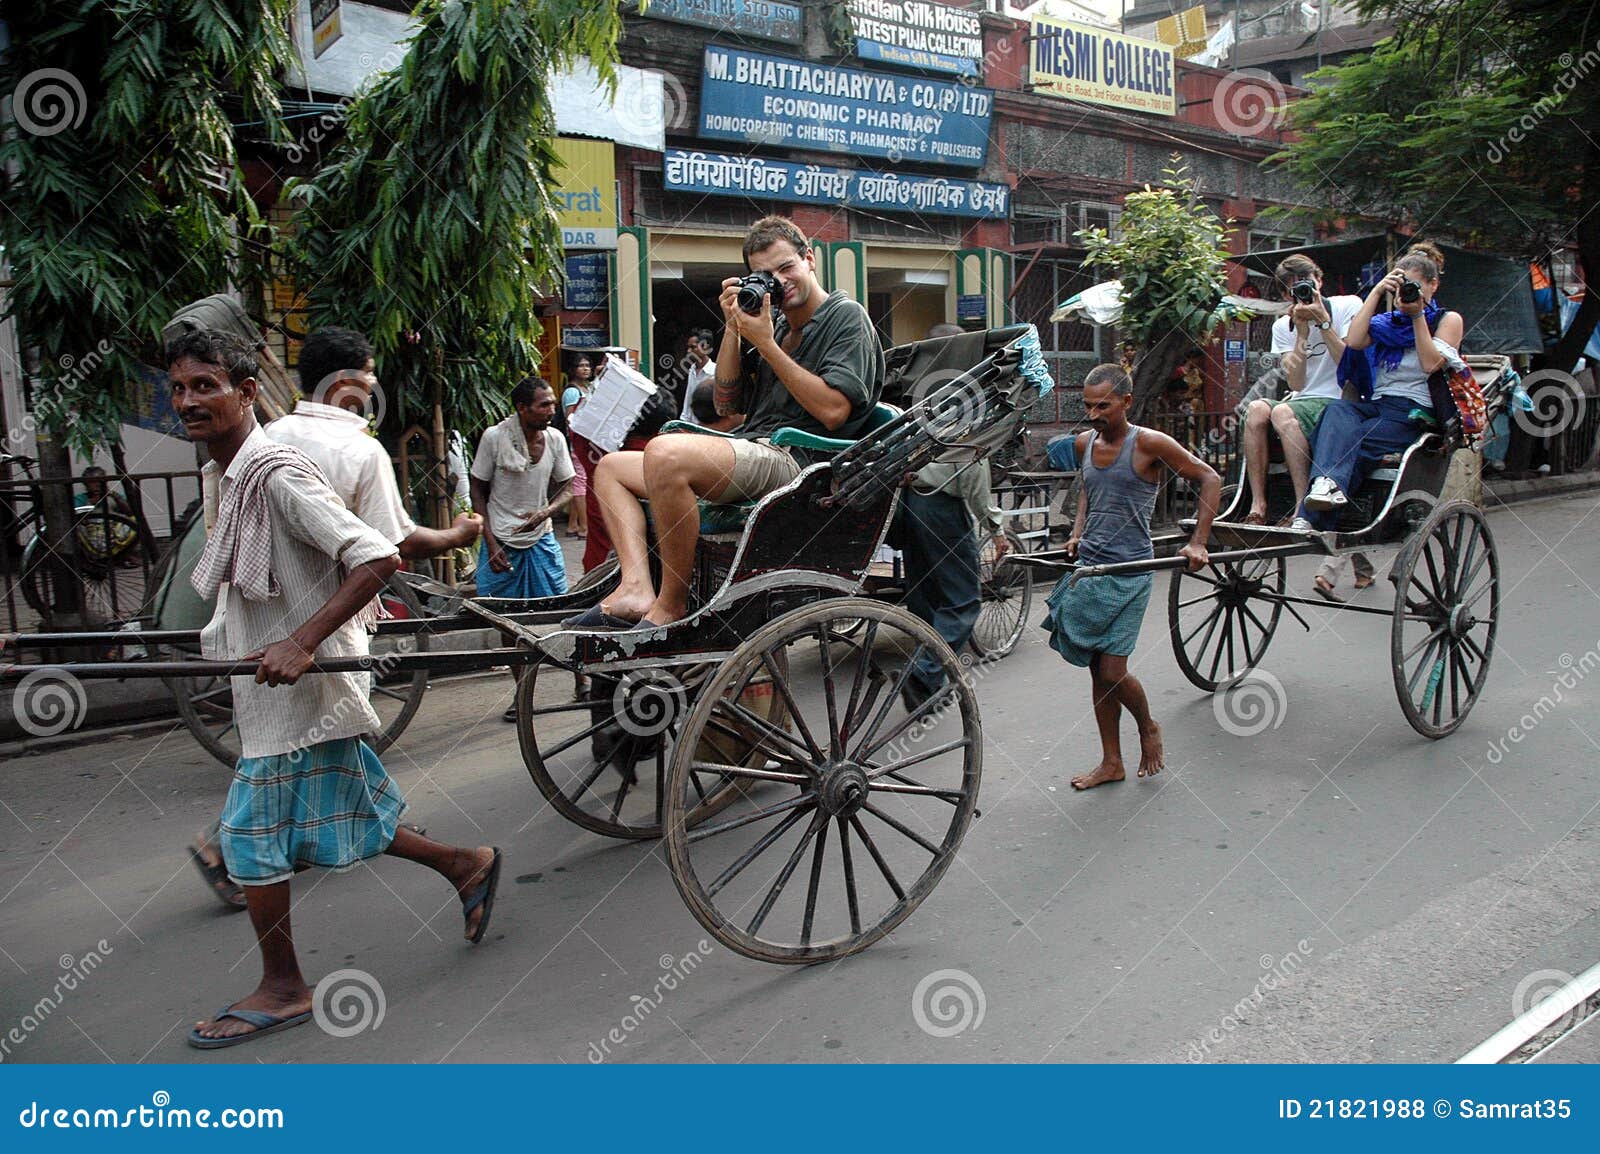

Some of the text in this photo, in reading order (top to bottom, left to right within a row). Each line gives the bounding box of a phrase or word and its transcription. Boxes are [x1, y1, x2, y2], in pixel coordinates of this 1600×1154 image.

[744, 0, 769, 16] STD
[774, 6, 794, 22] ISD
[903, 1, 934, 29] Silk
[934, 6, 980, 36] House
[898, 25, 928, 52] PUJA
[928, 33, 982, 58] COLLECTION
[1035, 22, 1172, 97] MESMI COLLEGE
[708, 52, 733, 81] M.
[899, 86, 908, 102] &
[962, 92, 990, 117] LTD.
[763, 95, 943, 135] ECONOMIC PHARMACY
[705, 114, 794, 138] HOMOEOPATHIC
[851, 133, 917, 153] PHARMACISTS
[920, 141, 928, 153] &
[931, 141, 982, 159] PUBLISHERS
